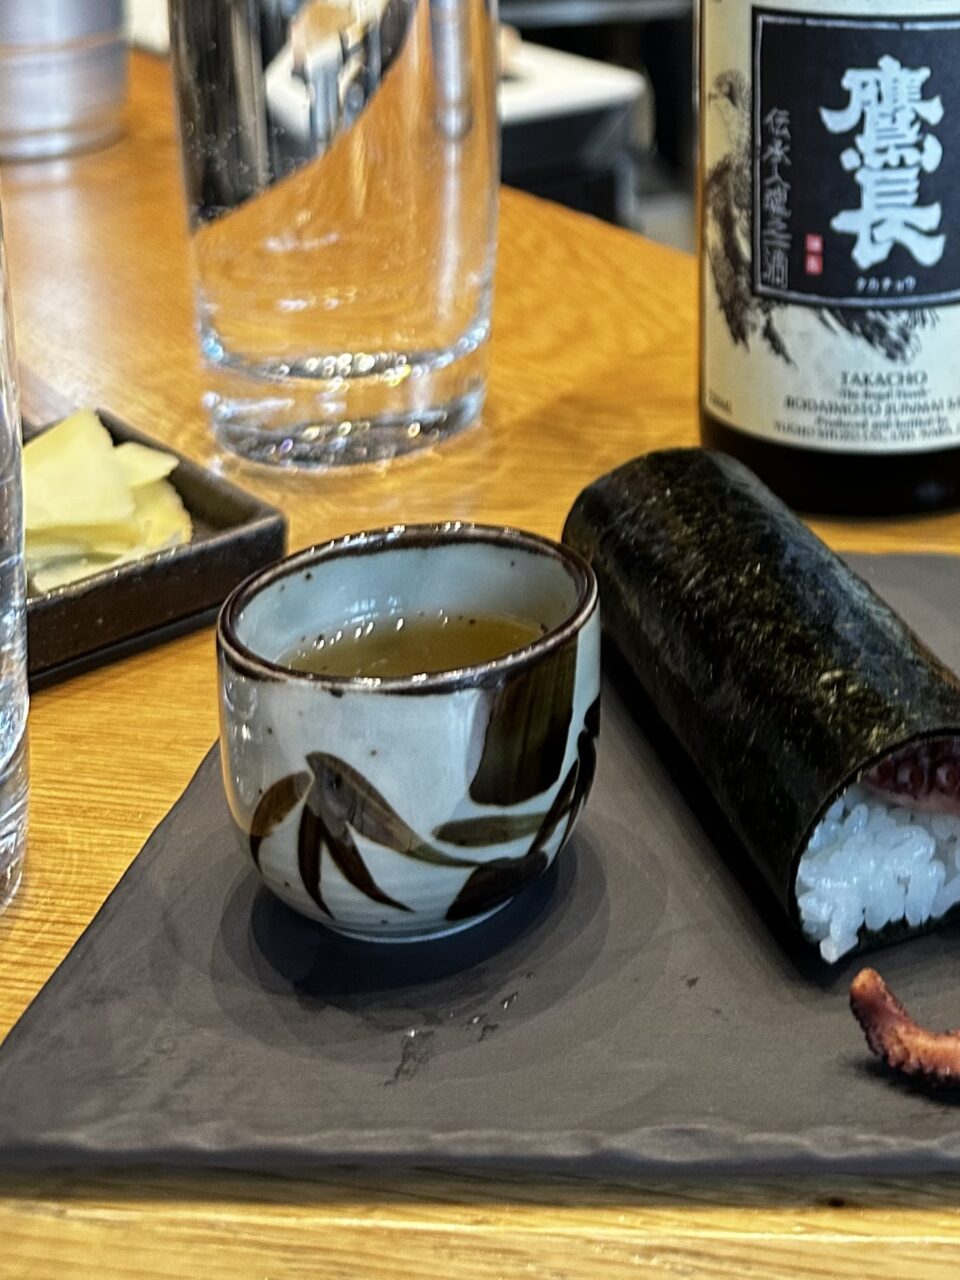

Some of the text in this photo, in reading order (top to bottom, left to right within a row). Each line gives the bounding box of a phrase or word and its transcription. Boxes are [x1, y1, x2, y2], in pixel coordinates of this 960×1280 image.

[819, 54, 946, 270] 鷹長
[840, 370, 928, 387] TAKACHO
[884, 398, 945, 417] JUNMAI
